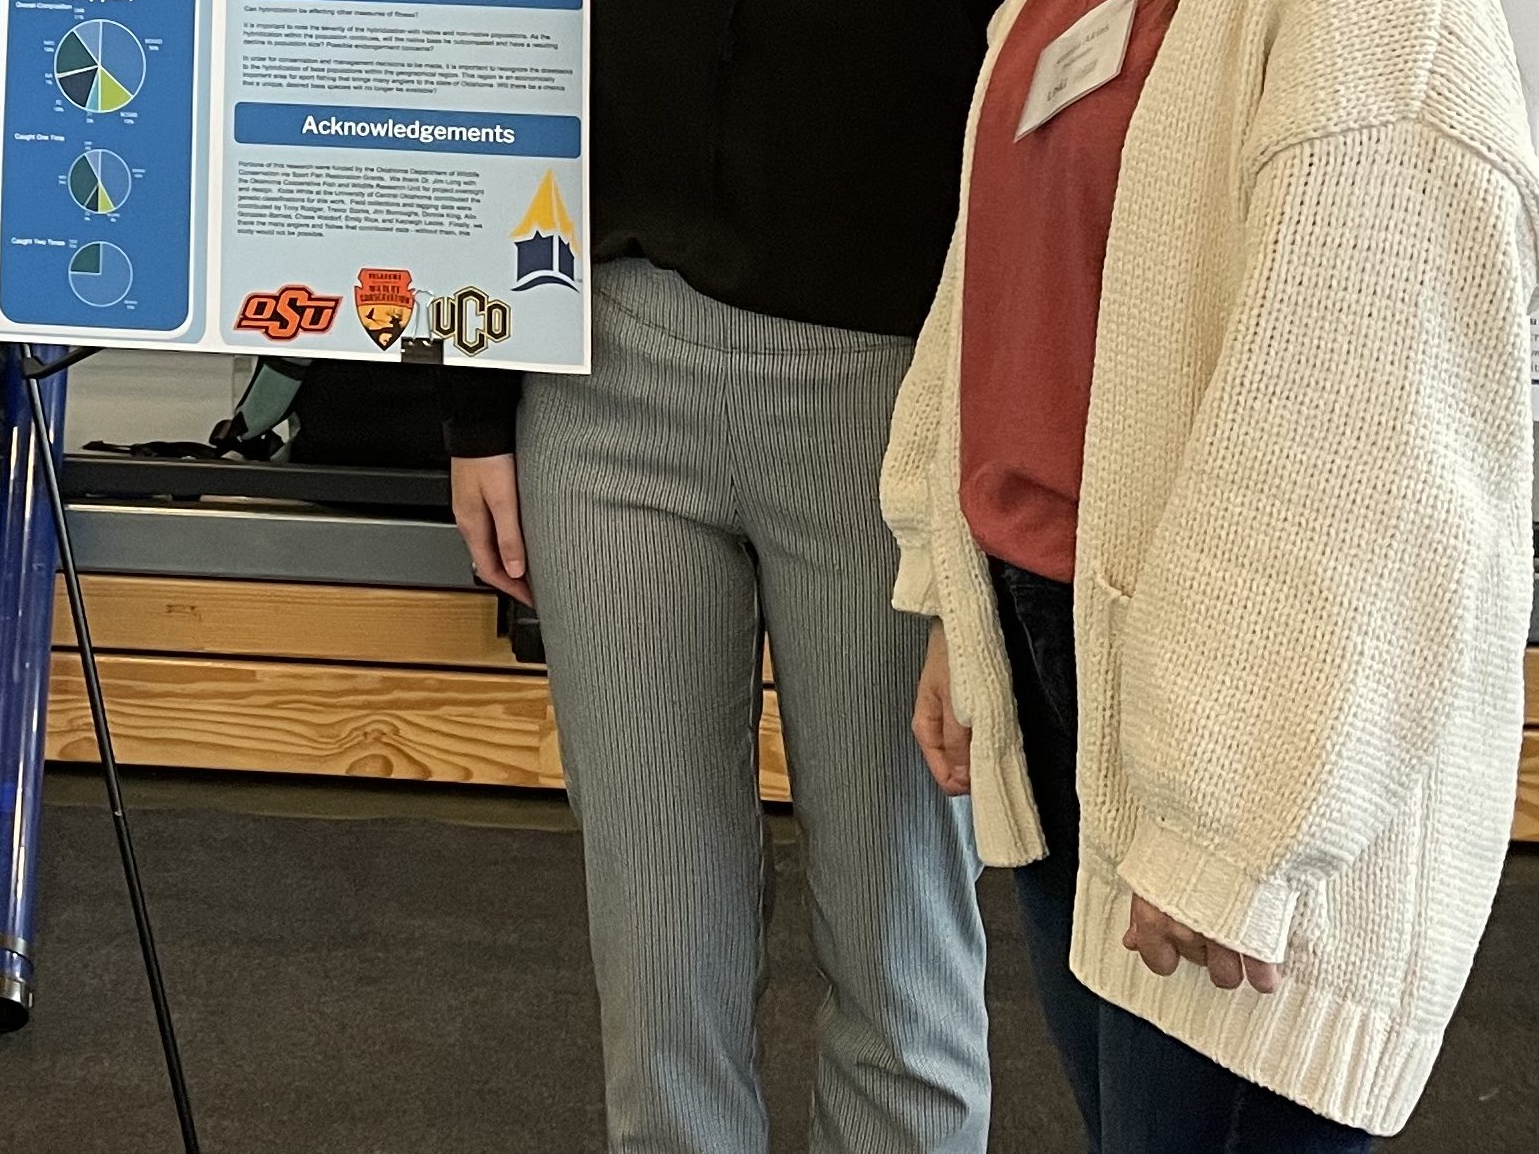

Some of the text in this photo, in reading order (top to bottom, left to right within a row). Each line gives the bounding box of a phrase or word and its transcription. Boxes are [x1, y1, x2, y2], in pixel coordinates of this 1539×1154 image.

[302, 116, 515, 144] Acknowledgements
[234, 284, 344, 342] OSU
[431, 286, 512, 357] UCO
